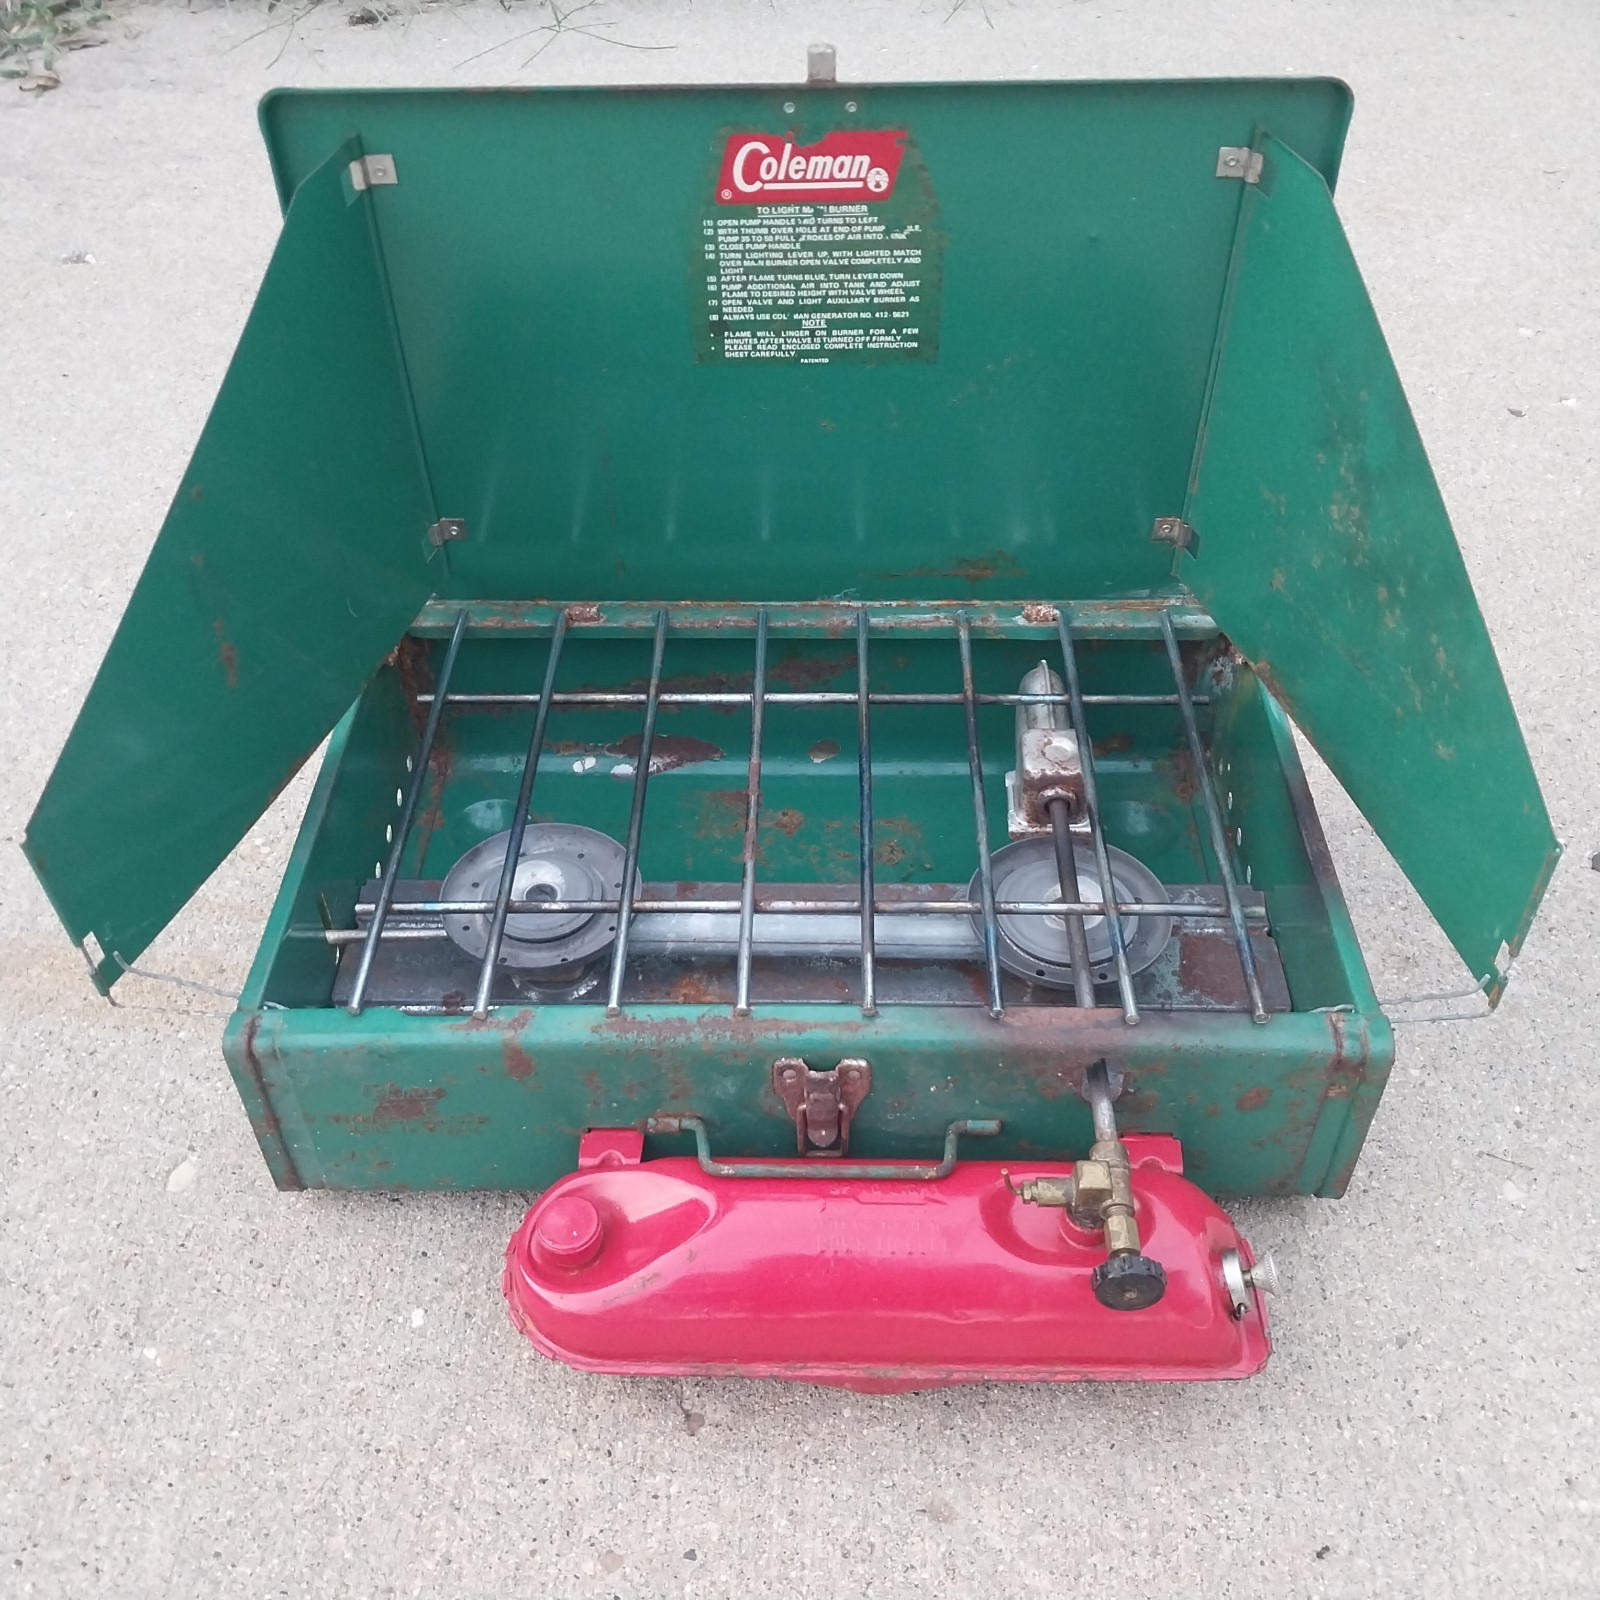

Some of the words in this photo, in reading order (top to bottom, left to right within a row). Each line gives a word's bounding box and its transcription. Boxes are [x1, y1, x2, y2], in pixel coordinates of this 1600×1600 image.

[733, 141, 870, 192] Coleman
[757, 206, 770, 214] TO
[772, 206, 800, 214] LIGHT
[829, 205, 868, 213] BURNER
[763, 218, 796, 226] HANDLE
